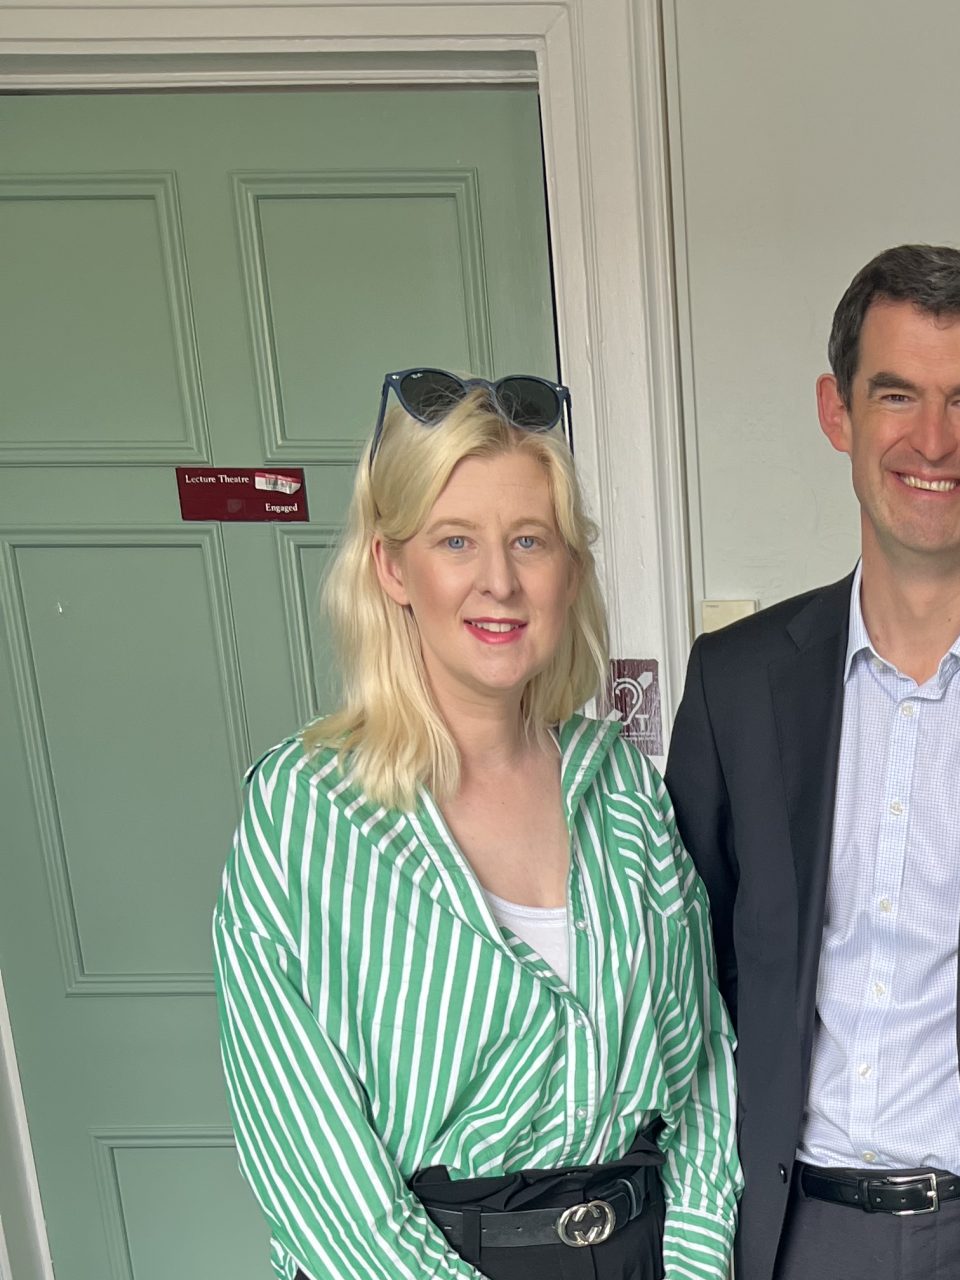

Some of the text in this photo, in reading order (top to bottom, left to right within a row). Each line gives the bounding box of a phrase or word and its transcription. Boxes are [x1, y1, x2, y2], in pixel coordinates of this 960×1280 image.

[185, 474, 250, 484] Lecture Theatre
[265, 503, 298, 513] Engaged
